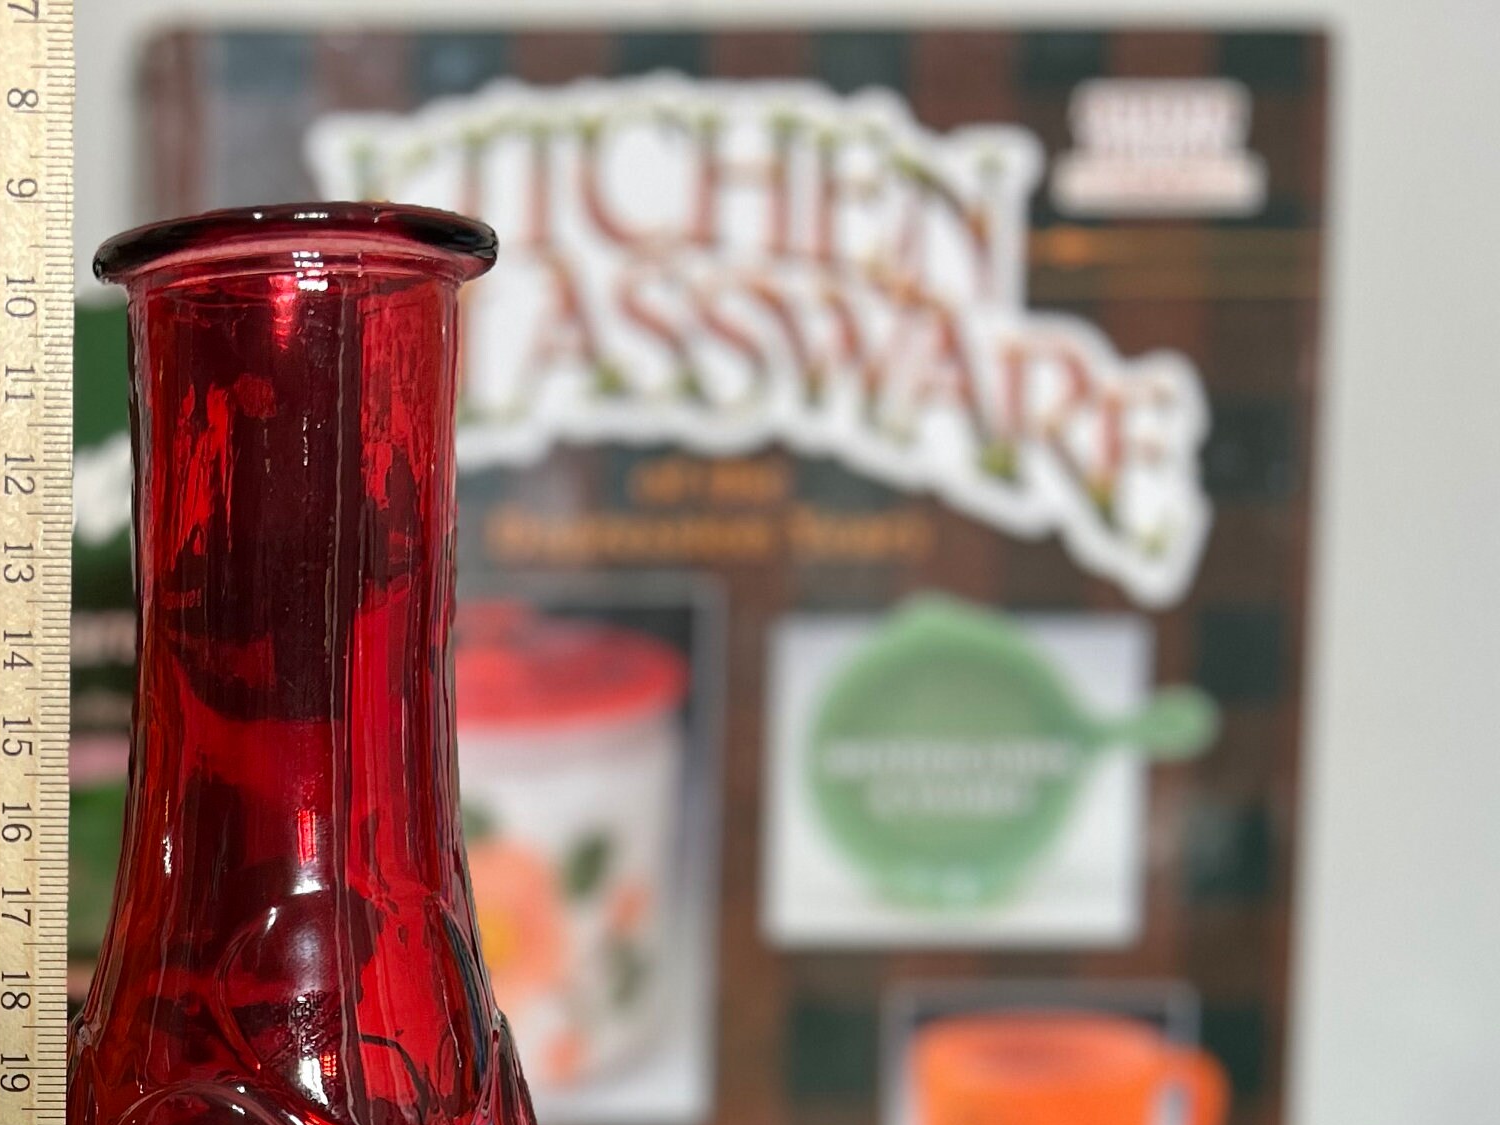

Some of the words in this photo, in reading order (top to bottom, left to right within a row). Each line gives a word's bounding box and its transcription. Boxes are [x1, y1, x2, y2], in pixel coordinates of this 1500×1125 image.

[7, 88, 39, 109] 8
[7, 178, 38, 198] 9
[5, 275, 36, 319] 10
[5, 365, 35, 403] 11
[4, 453, 35, 496] 12
[3, 542, 34, 584] 13
[3, 631, 33, 670] 14
[2, 717, 33, 757] 15
[1, 803, 32, 843] 16
[1, 888, 32, 927] 17
[0, 972, 31, 1011] 18
[0, 1053, 30, 1094] 19
